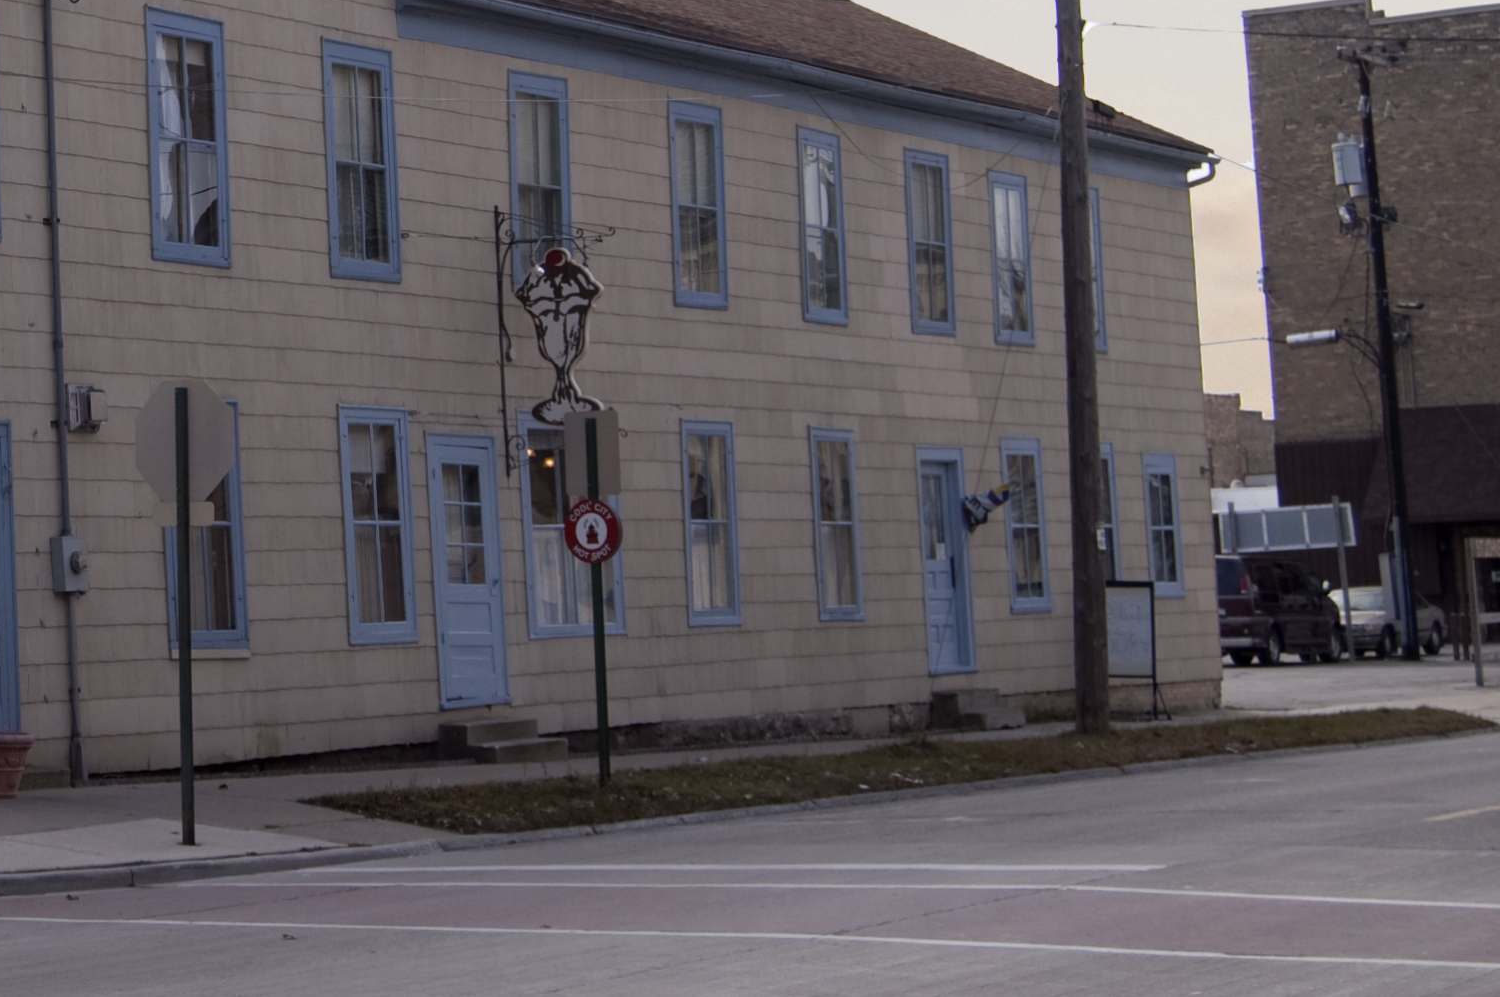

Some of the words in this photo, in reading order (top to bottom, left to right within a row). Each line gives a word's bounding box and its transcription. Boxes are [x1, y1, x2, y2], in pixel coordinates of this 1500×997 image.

[569, 501, 592, 522] COOL
[594, 503, 613, 519] CITY
[573, 545, 589, 559] HOT
[590, 545, 611, 562] SPOT
